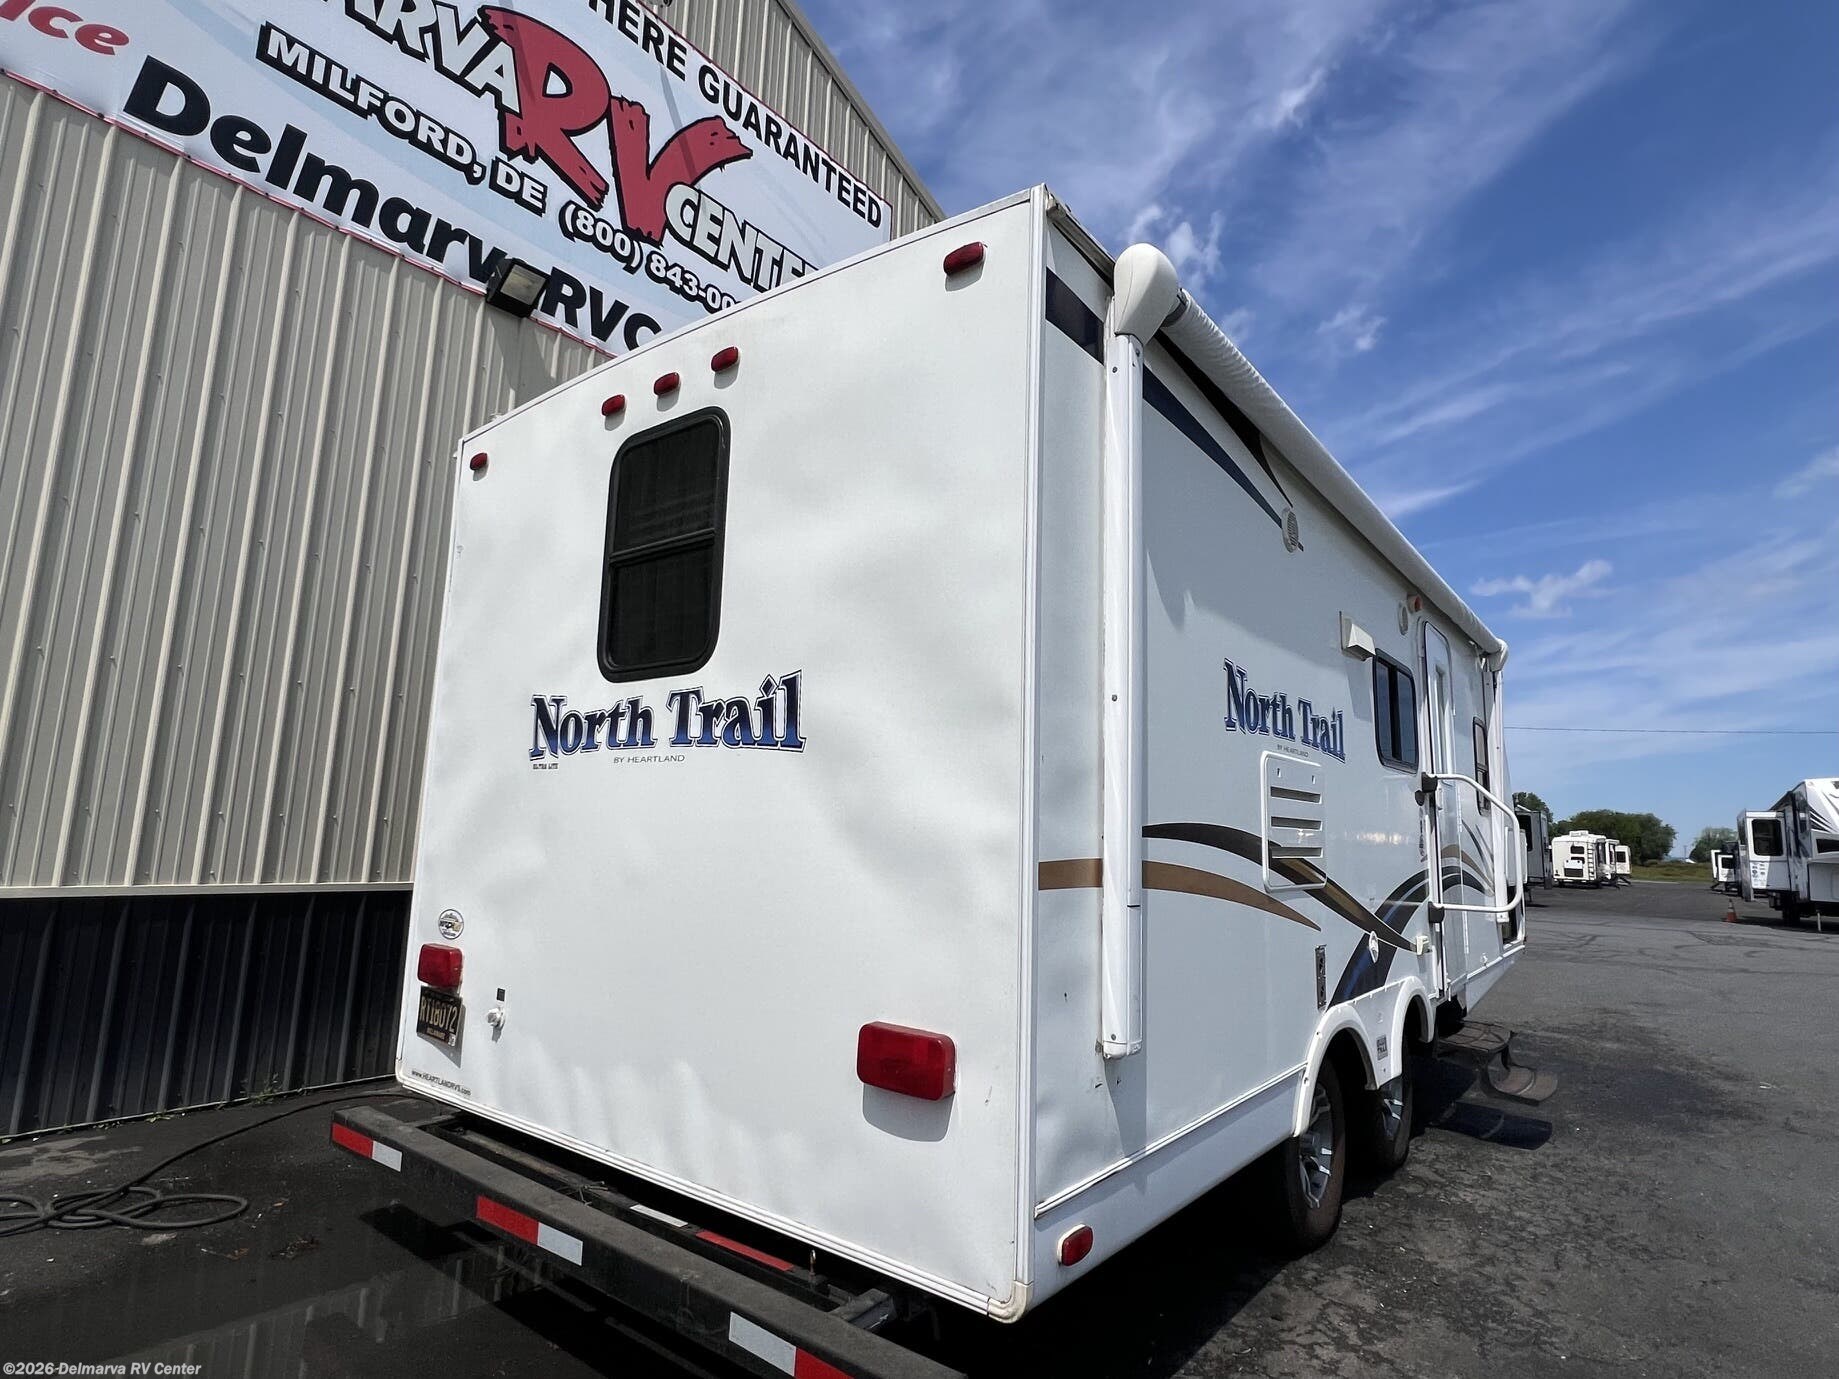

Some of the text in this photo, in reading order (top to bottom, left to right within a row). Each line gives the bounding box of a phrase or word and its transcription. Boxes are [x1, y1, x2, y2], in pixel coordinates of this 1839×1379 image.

[123, 55, 662, 351] DelmarvRVC
[257, 22, 486, 183] MILFORD,
[490, 156, 547, 216] DE
[560, 201, 643, 273] (800)
[478, 6, 752, 247] RV
[664, 182, 815, 293] CENTE
[698, 64, 882, 229] GUARANTEED
[529, 667, 807, 761] North Trail
[613, 754, 685, 764] BY HEARTLAND
[1223, 658, 1346, 764] North Trail
